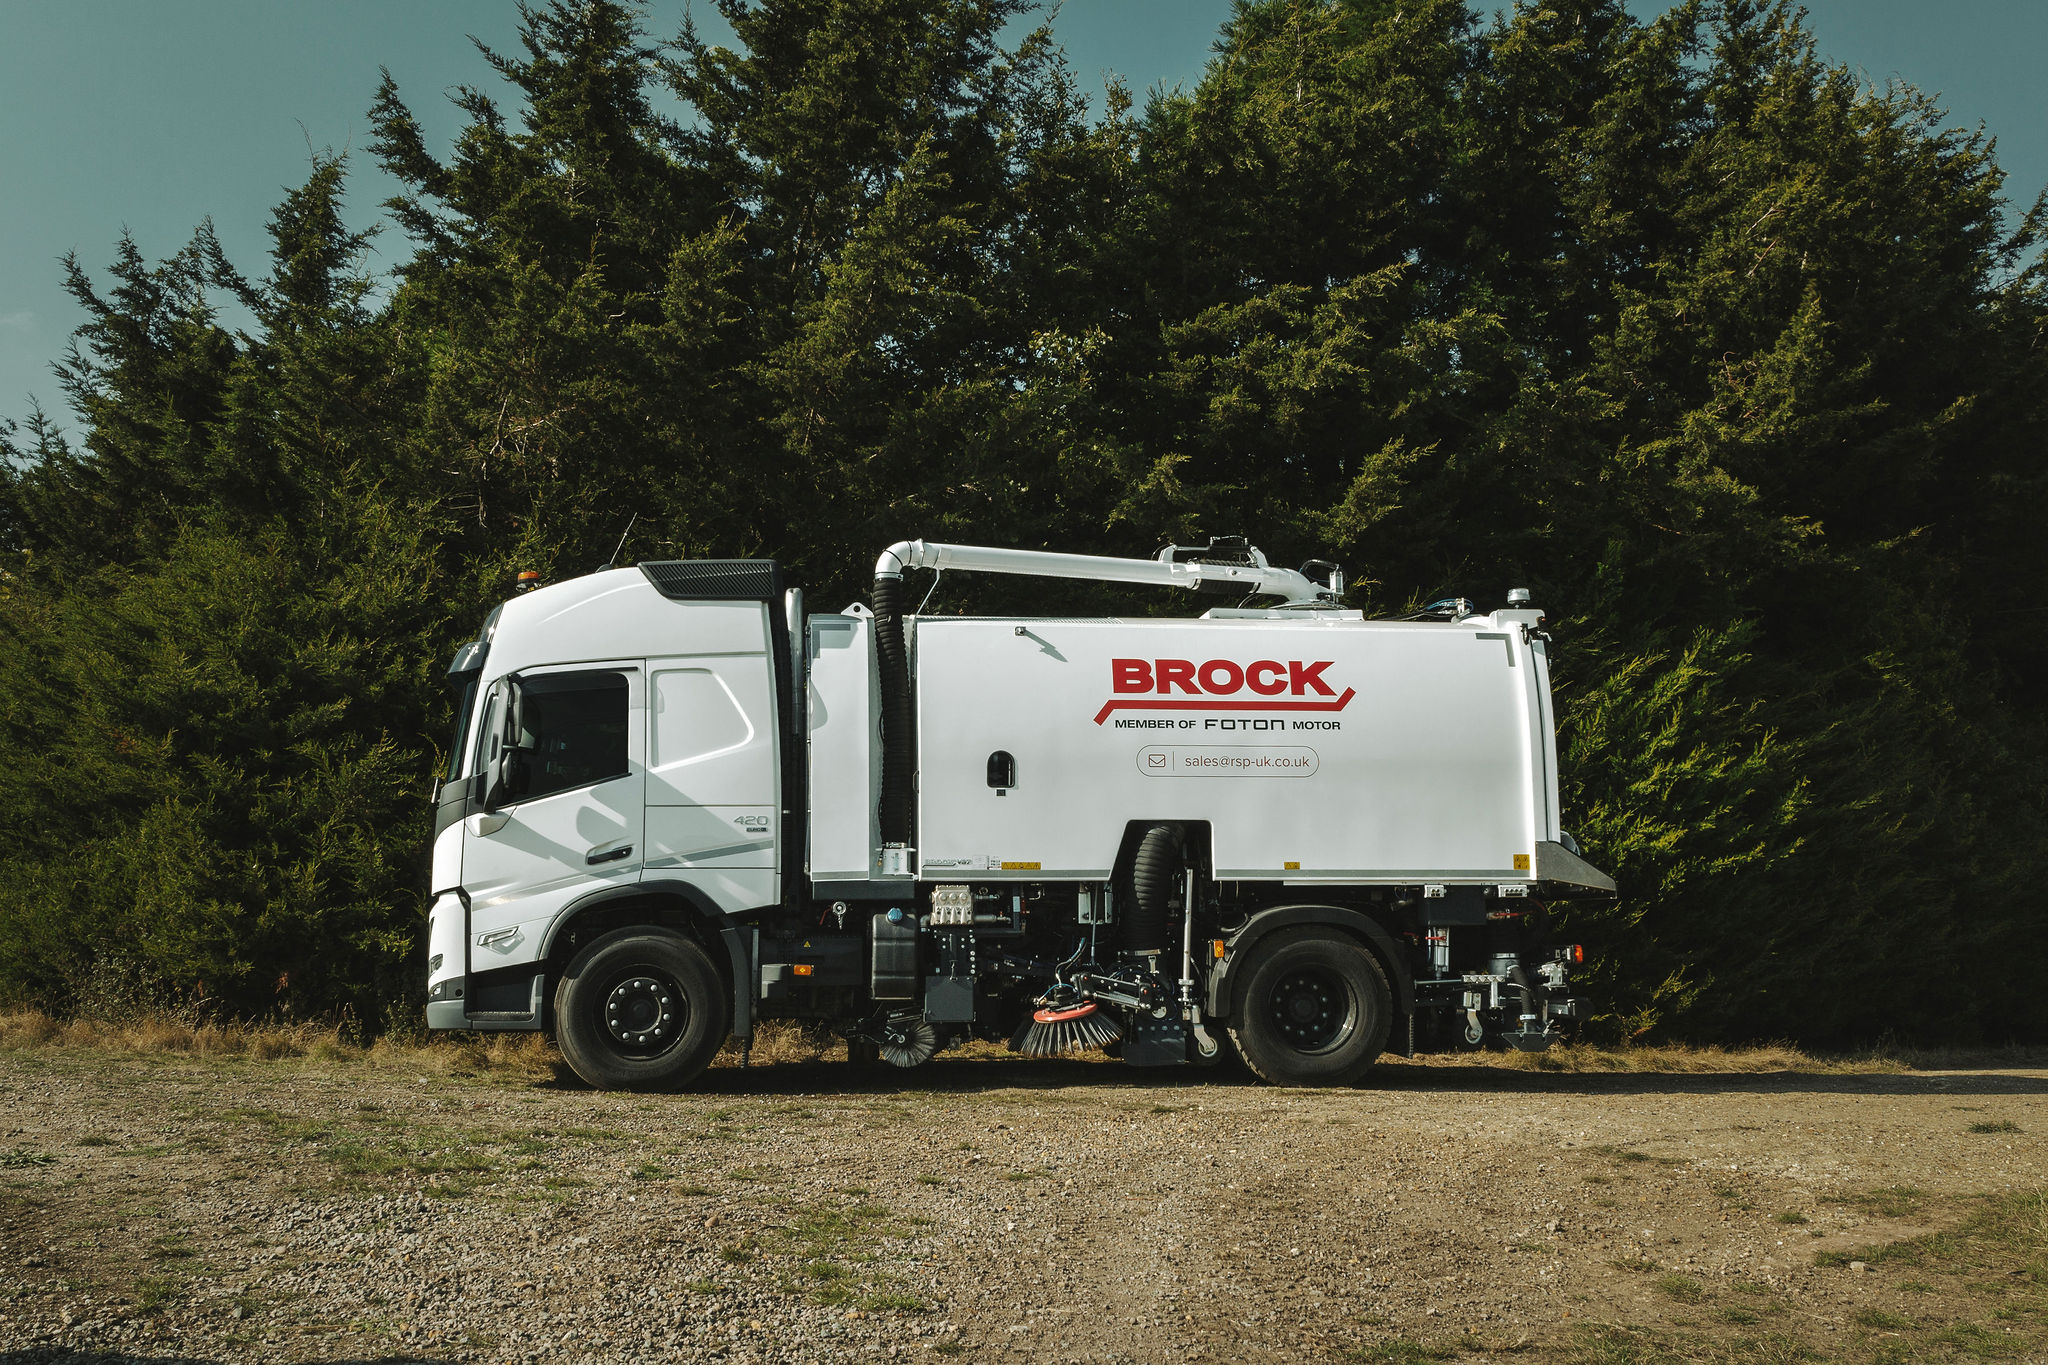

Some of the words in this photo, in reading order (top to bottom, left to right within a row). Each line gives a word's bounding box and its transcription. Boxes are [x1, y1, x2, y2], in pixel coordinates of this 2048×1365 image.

[1112, 658, 1337, 697] BROCK
[1115, 719, 1174, 729] MEMBER
[1178, 719, 1197, 729] OF
[1204, 719, 1286, 731] FOTON
[1292, 721, 1342, 731] MOTOR
[1185, 755, 1310, 770] sales@rsp-uk.co.uk
[734, 815, 768, 826] 420
